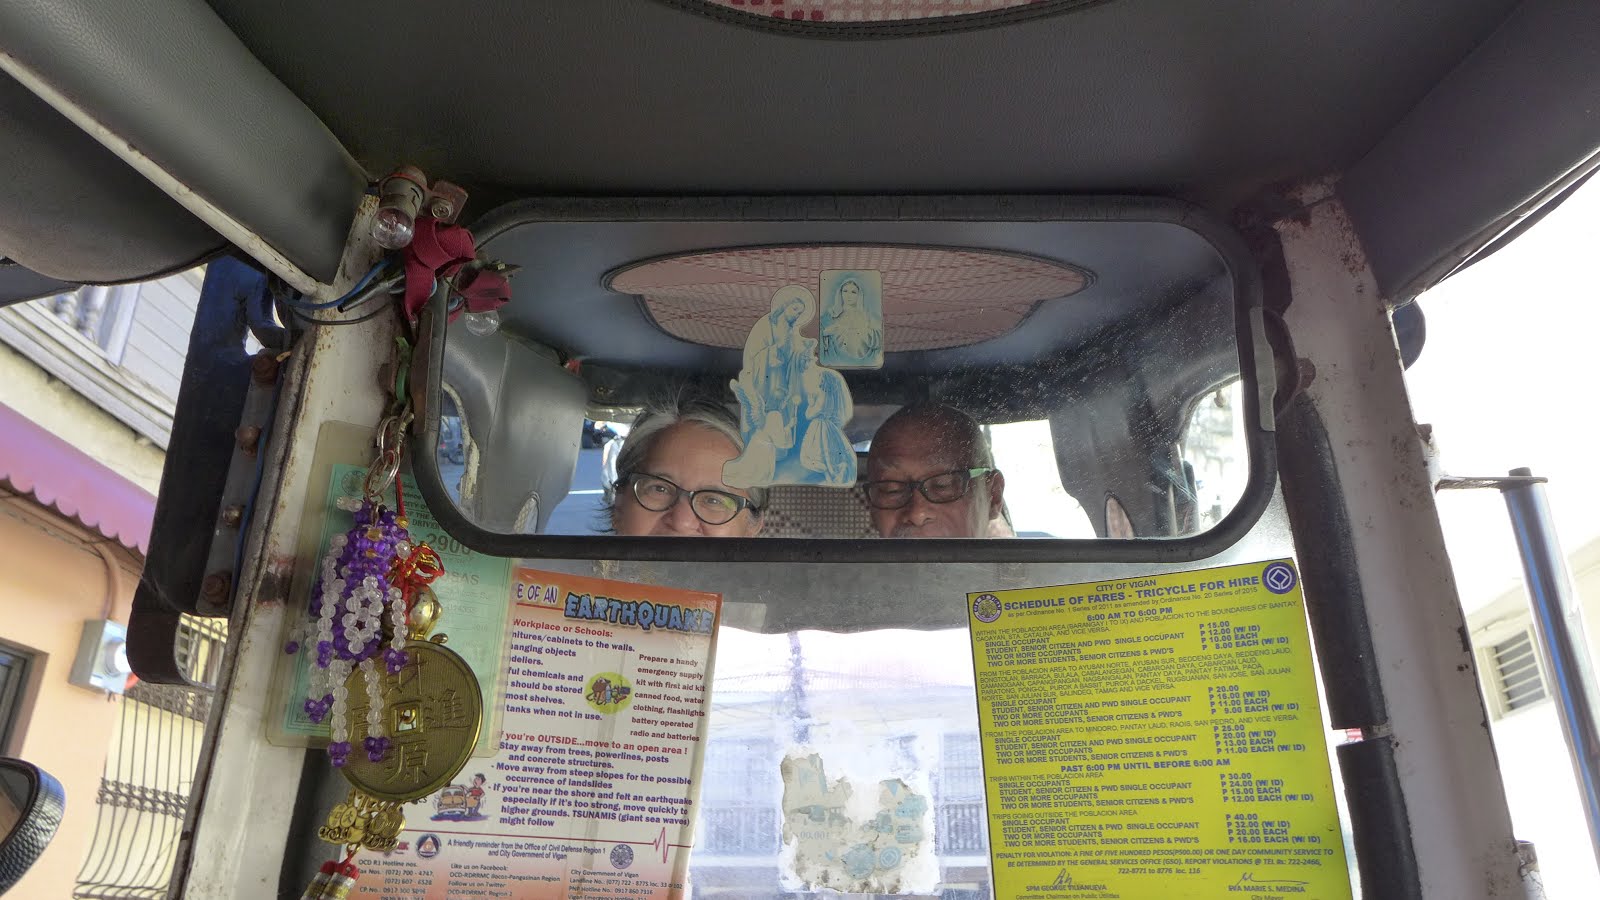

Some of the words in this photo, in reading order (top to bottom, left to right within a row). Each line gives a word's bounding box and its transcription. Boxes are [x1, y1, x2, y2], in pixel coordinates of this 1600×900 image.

[1095, 584, 1113, 592] CITY
[1115, 582, 1126, 590] OF
[1128, 579, 1156, 588] VIGAN
[527, 585, 541, 600] OF
[544, 587, 558, 604] AN
[1004, 597, 1065, 610] SCHEDULE
[1068, 596, 1084, 604] OF
[1087, 592, 1125, 603] FARES
[1135, 584, 1196, 598] TRICYCLE
[1199, 580, 1225, 591] FOR
[1228, 576, 1259, 587] HIRE
[564, 592, 714, 634] EARTHQUAKE
[1087, 613, 1105, 621] 6:00
[1138, 608, 1156, 616] 6:00
[1159, 606, 1172, 614] PM
[1207, 620, 1229, 628] 15.00
[574, 626, 612, 637] Schools:
[1208, 627, 1230, 635] 12.00
[1209, 634, 1232, 642] 10.00
[1234, 632, 1258, 640] EACH
[1011, 637, 1050, 645] OCCUPANT
[1114, 636, 1142, 644] SINGLE
[1143, 632, 1184, 642] OCCUPANT
[1235, 639, 1259, 647] EACH
[545, 647, 576, 656] objects
[585, 639, 593, 647] to
[596, 640, 609, 648] the
[611, 644, 635, 652] walls.
[509, 655, 543, 665] deliers.
[639, 654, 668, 663] Prepare
[676, 658, 698, 667] handy
[521, 669, 565, 680] chemicals
[637, 667, 677, 677] emergency
[679, 673, 704, 681] supply
[510, 680, 540, 689] should
[542, 683, 552, 691] be
[555, 684, 582, 694] stored
[529, 695, 565, 704] shelves.
[634, 692, 661, 700] canned
[663, 694, 682, 703] food,
[506, 705, 531, 713] tanks
[533, 708, 556, 716] when
[558, 710, 572, 718] not
[574, 710, 582, 718] in
[633, 704, 665, 714] clothing,
[666, 707, 705, 717] flashlights
[631, 716, 658, 726] battery
[660, 720, 693, 728] operated
[505, 733, 535, 741] you're
[537, 734, 609, 748] OUTSIDE...move
[666, 732, 699, 741] batteries
[500, 742, 519, 752] Stay
[520, 745, 543, 754] away
[545, 745, 566, 754] from
[568, 747, 592, 757] trees,
[594, 751, 643, 762] powerlines,
[645, 755, 669, 763] posts
[527, 756, 565, 764] concrete
[567, 758, 614, 768] structures.
[1060, 764, 1083, 772] PAST
[1123, 762, 1151, 770] UNTIL
[1153, 760, 1191, 768] BEFORE
[1193, 759, 1213, 767] 6:00
[1216, 758, 1230, 766] AM
[496, 763, 520, 771] Move
[522, 766, 544, 774] away
[546, 766, 567, 775] from
[569, 769, 594, 778] steep
[596, 770, 624, 780] slopes
[626, 772, 638, 780] for
[640, 774, 654, 782] the
[656, 776, 691, 785] possible
[1228, 772, 1251, 780] 30.00
[502, 796, 548, 806] especially
[590, 801, 620, 811] strong,
[647, 805, 678, 815] quickly
[680, 807, 688, 815] to
[499, 817, 525, 826] might
[527, 818, 554, 826] follow
[501, 806, 530, 815] higher
[531, 808, 569, 817] grounds.
[572, 810, 616, 820] TSUNAMIS
[618, 813, 643, 822] (giant
[662, 817, 689, 827] waves)
